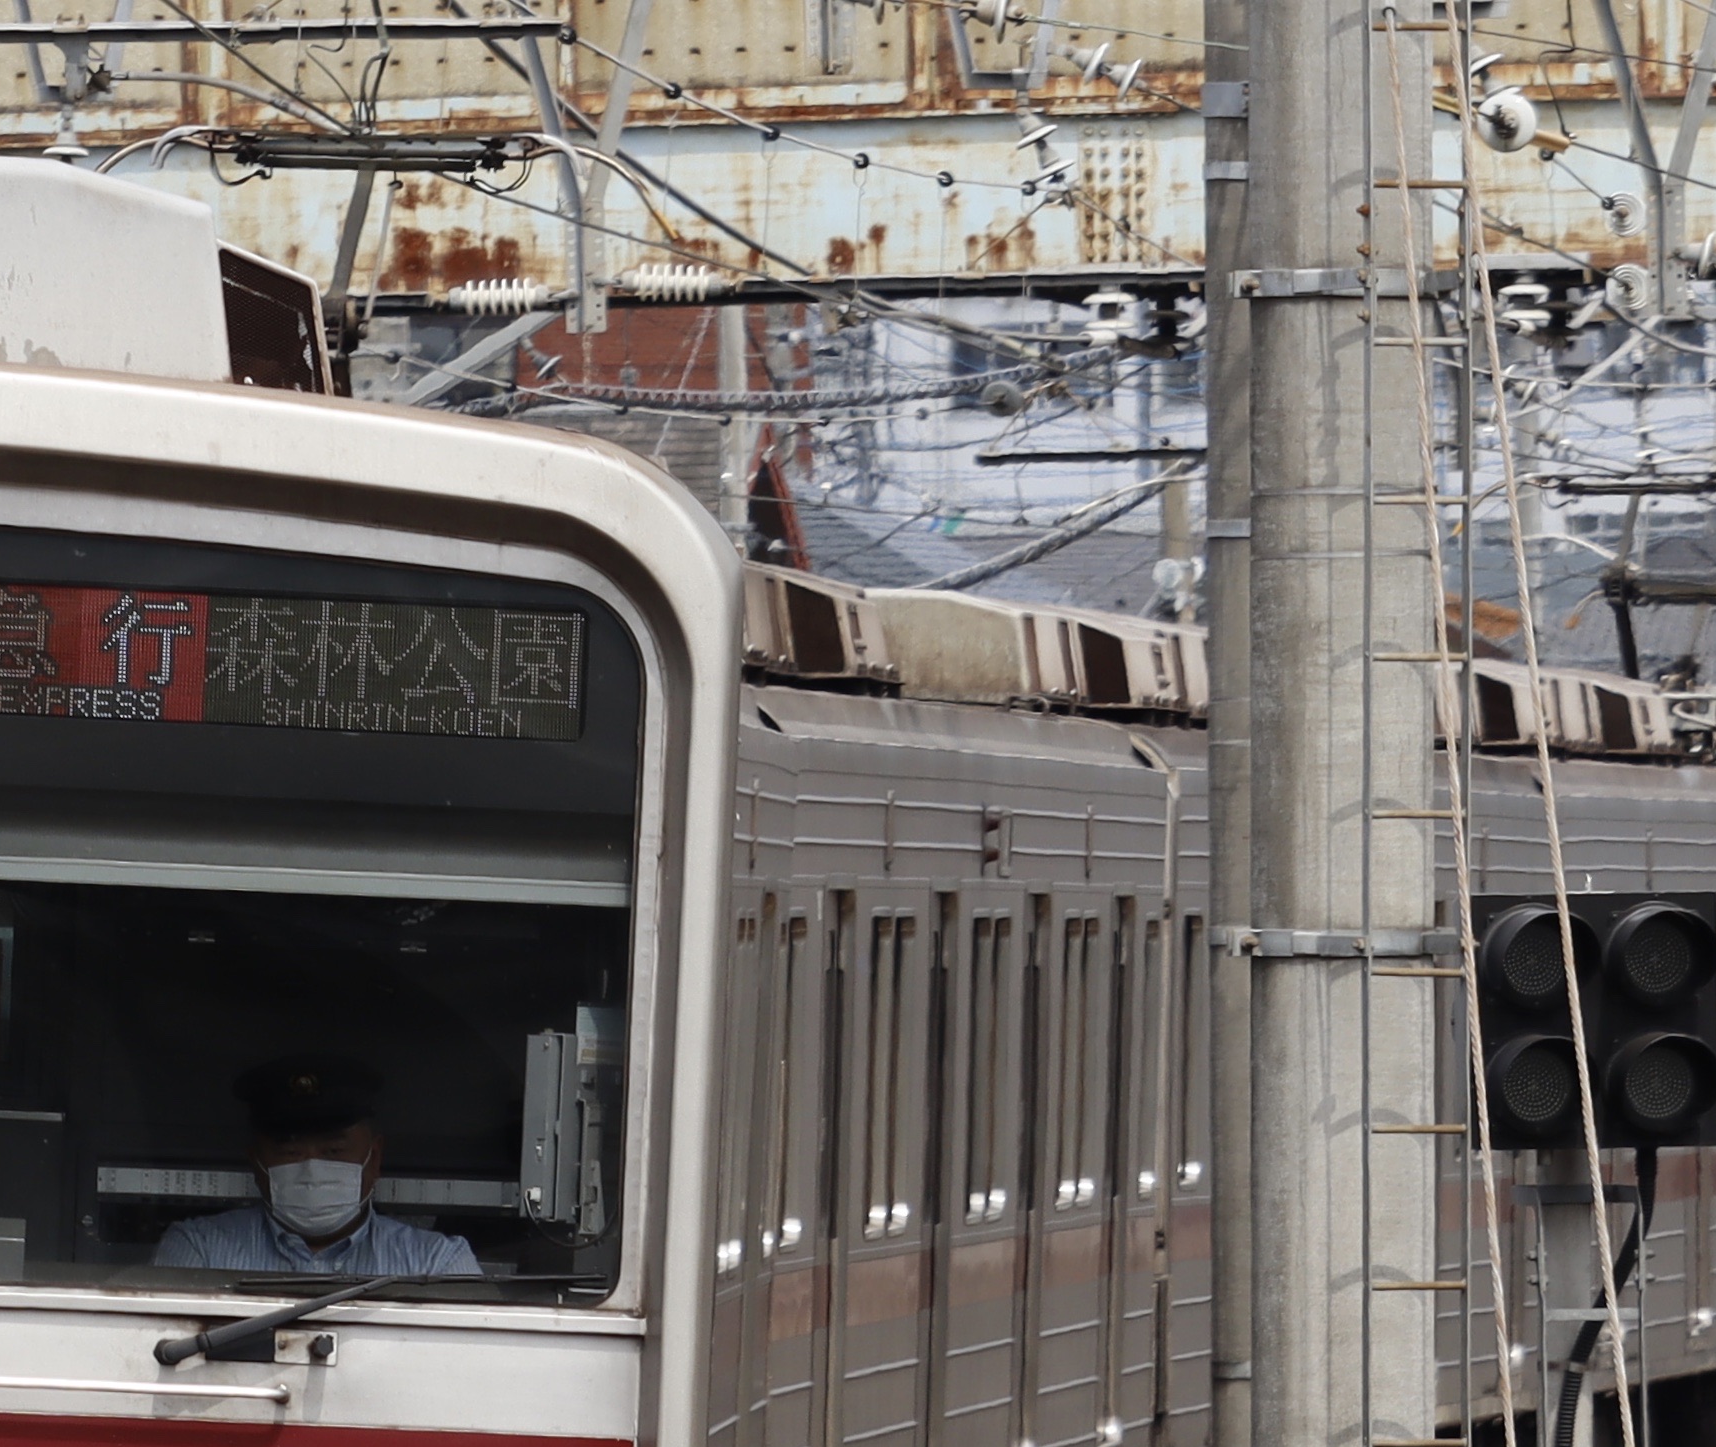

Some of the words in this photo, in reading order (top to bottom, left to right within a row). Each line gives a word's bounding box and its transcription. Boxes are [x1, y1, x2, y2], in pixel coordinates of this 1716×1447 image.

[205, 597, 585, 710] 森林公園
[261, 697, 522, 738] SHINRIN-KOEN
